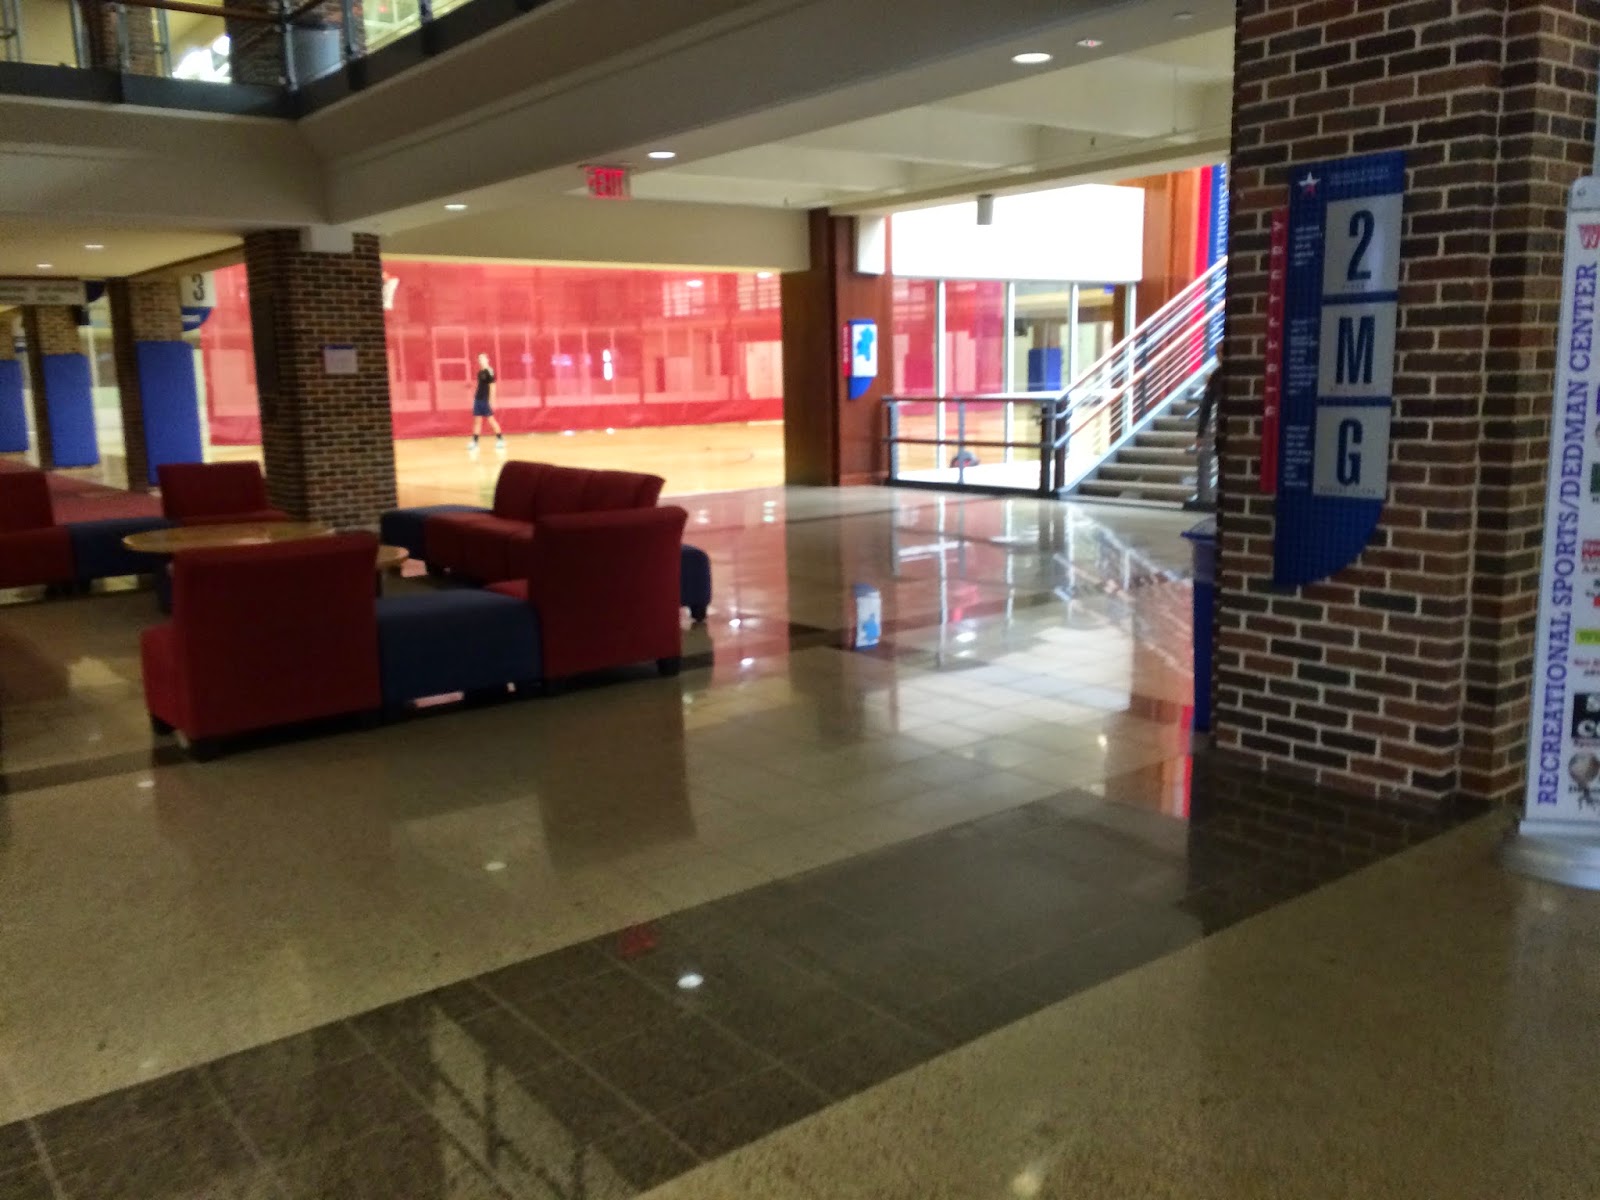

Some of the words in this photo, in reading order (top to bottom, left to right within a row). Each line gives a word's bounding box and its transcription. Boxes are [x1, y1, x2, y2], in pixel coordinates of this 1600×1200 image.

[595, 168, 625, 197] EXIT
[1347, 209, 1375, 281] 2
[192, 274, 205, 301] 3
[1264, 220, 1284, 417] DIRECTORY
[1569, 260, 1598, 372] CENTER
[1336, 316, 1375, 384] M
[1336, 418, 1363, 486] G
[1552, 379, 1589, 606] SPORTS/DEDMAN
[1537, 611, 1572, 805] RECREATIONAL
